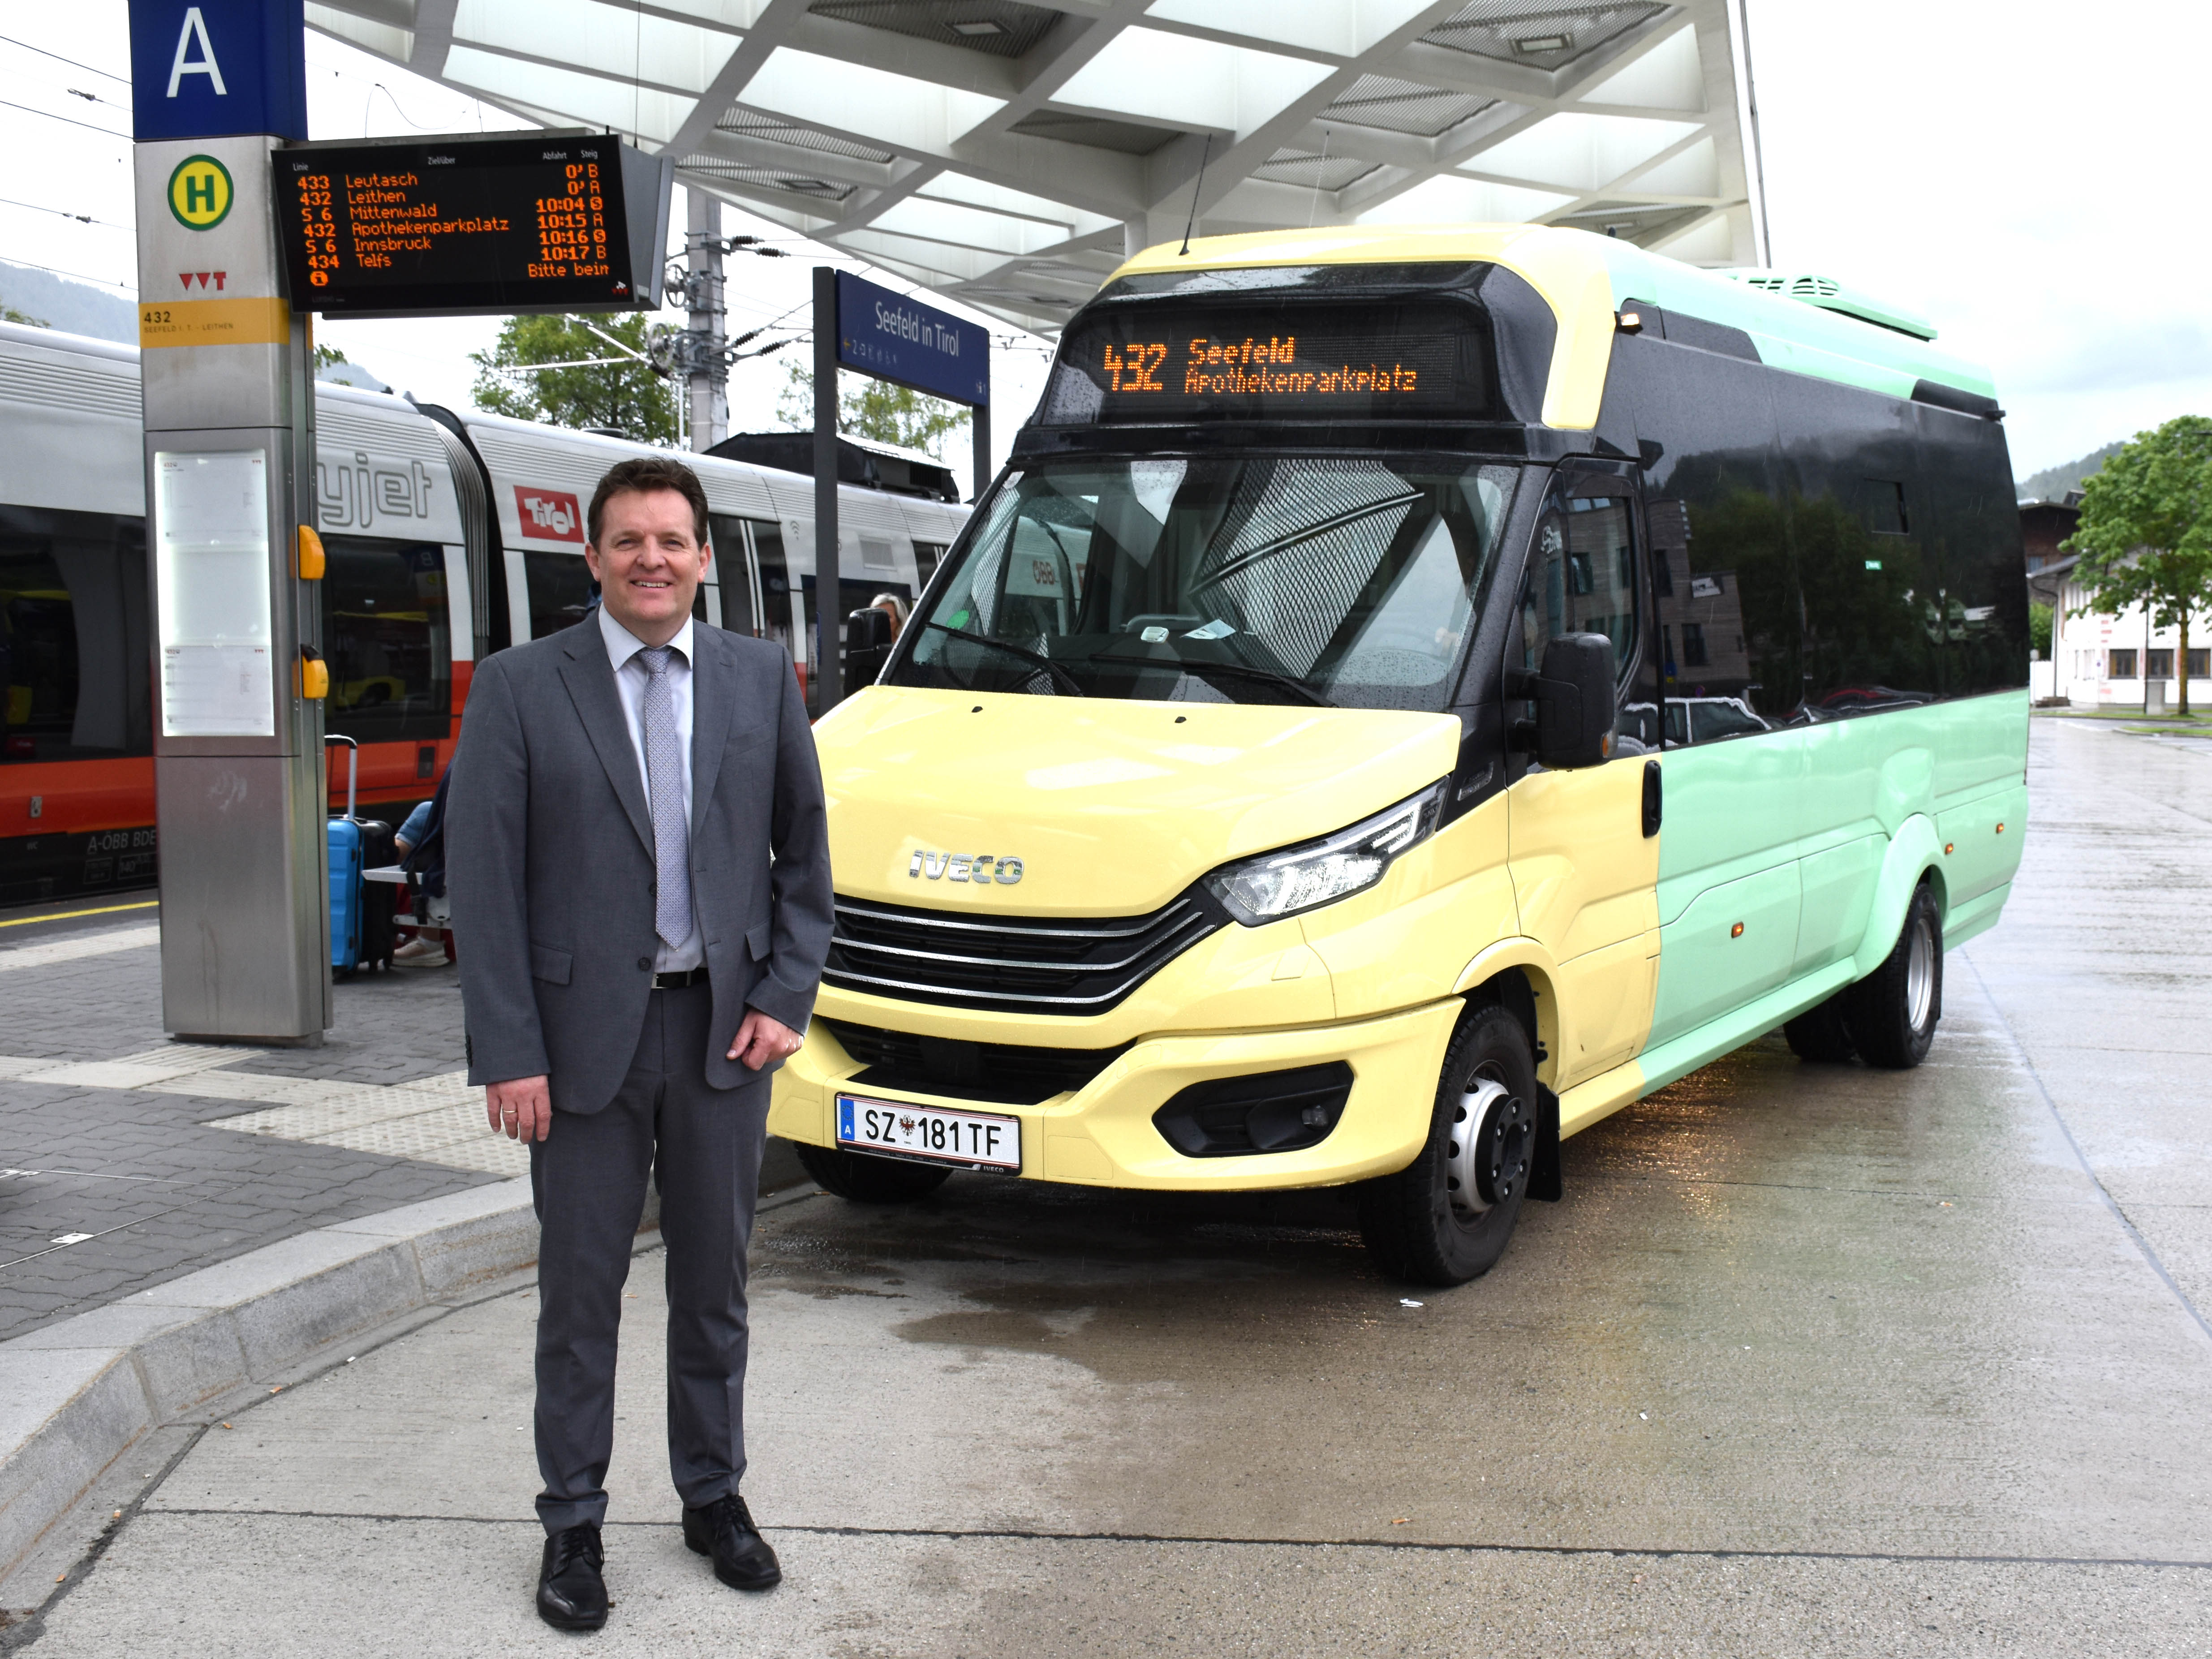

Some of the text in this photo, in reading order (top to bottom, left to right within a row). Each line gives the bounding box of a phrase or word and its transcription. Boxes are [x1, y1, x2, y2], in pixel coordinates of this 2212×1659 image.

[166, 7, 228, 98] A
[293, 163, 309, 171] Linie
[543, 150, 598, 160] Abfahrt Steig
[297, 175, 330, 189] 433
[345, 172, 418, 188] Leutasch
[588, 164, 599, 178] B
[185, 174, 215, 214] H
[300, 191, 332, 206] 432
[348, 189, 406, 204] Leithen
[590, 180, 601, 194] A
[349, 203, 438, 220] Mittenwald
[535, 197, 585, 213] 10:04
[304, 212, 603, 237] 432 Apothekenparkplatz 10:15 A
[353, 236, 432, 252] Innsbruck
[539, 229, 589, 245] 10:16
[308, 245, 607, 269] 434 Telfs 10:17 B
[528, 263, 567, 278] Bitte
[144, 311, 171, 323] 432
[144, 325, 176, 333] SEEFELD
[875, 301, 959, 357] Seefeld in Tirol
[1104, 336, 1295, 392] 432 Seefeld
[1185, 364, 1418, 394] Apothekenparkplatz
[525, 497, 576, 535] Tirol
[88, 831, 129, 854] A-ÖBB
[909, 849, 1024, 885] IVECO
[845, 1125, 851, 1135] A
[865, 1109, 896, 1143] SZ
